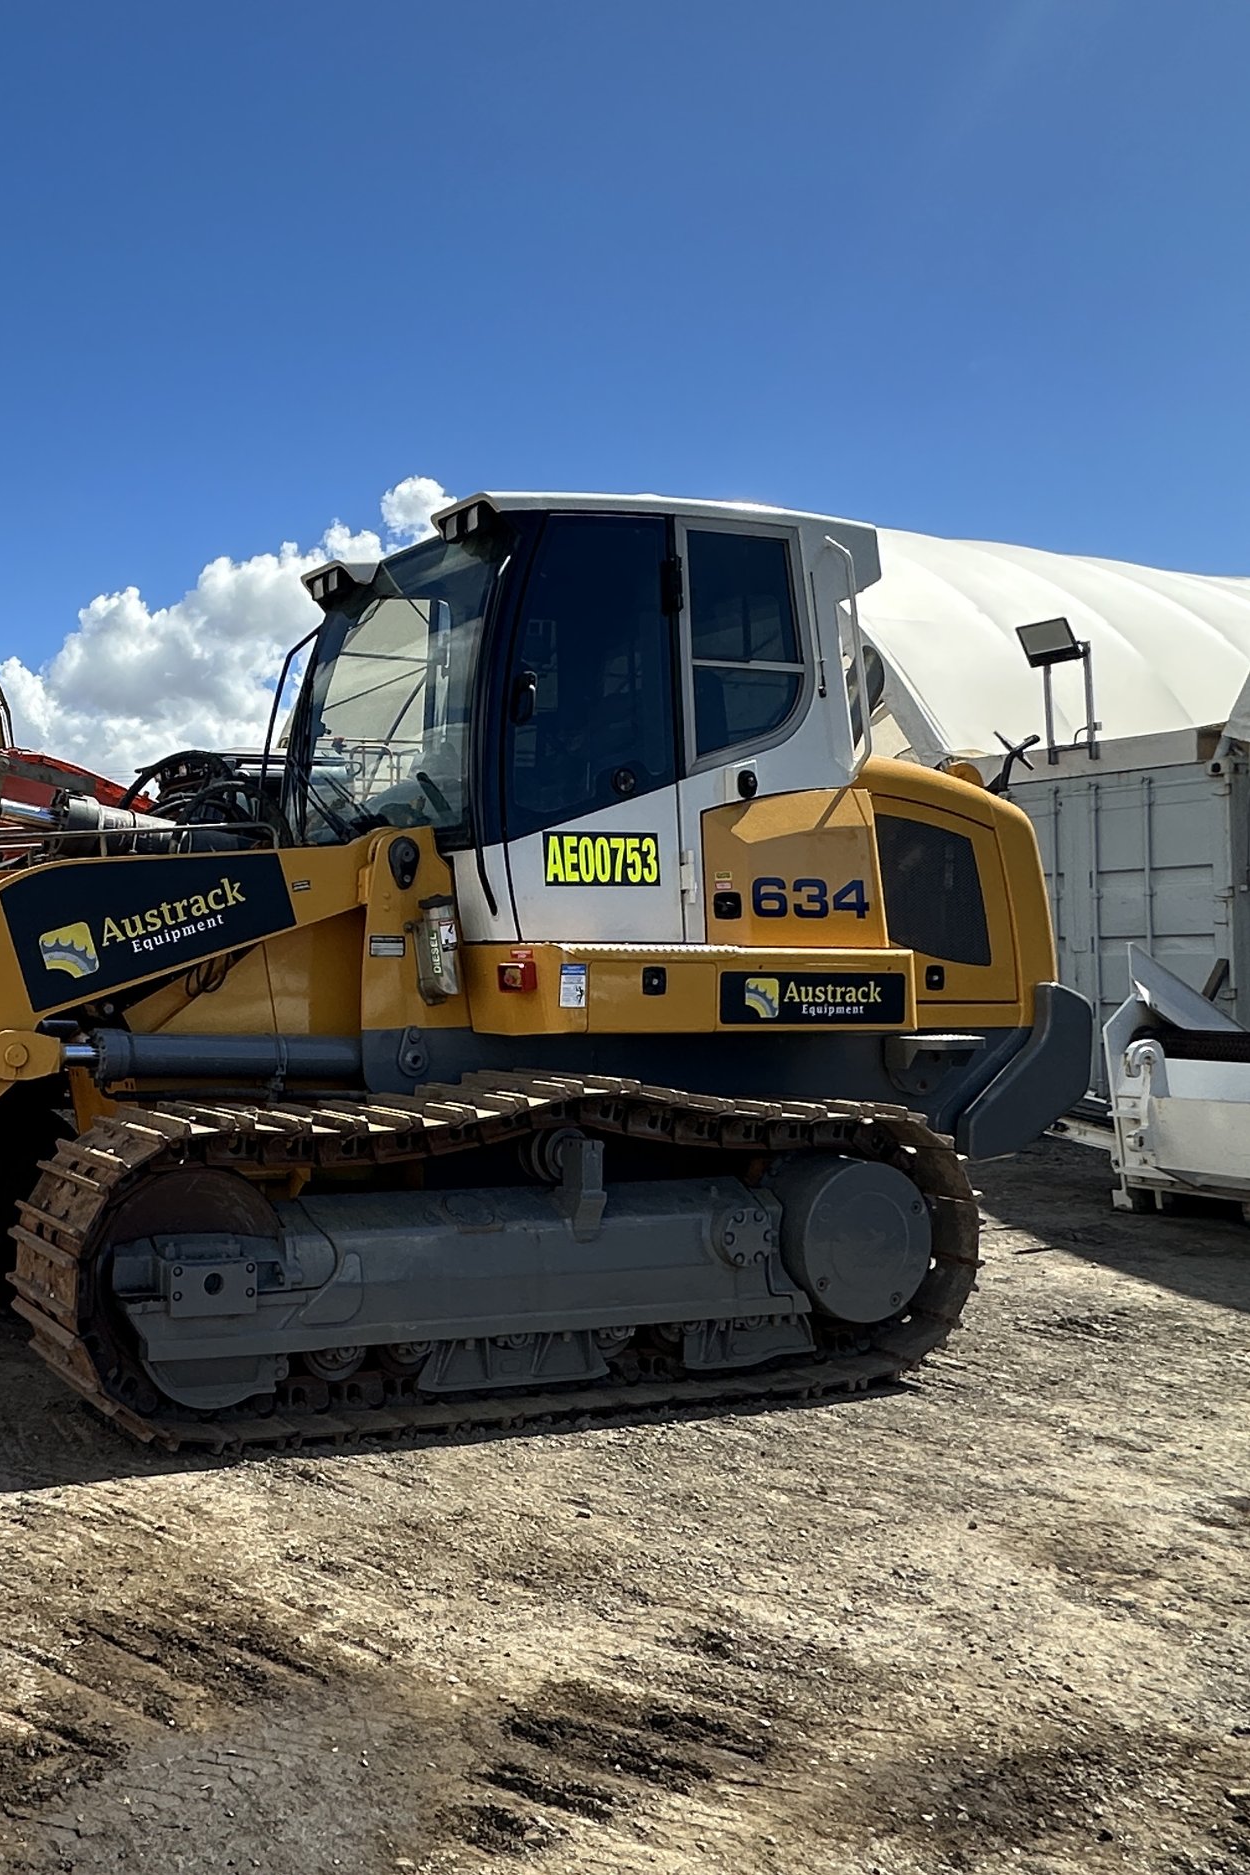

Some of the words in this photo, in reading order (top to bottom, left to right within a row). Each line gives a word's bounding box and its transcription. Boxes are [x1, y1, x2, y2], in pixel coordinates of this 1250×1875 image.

[546, 835, 658, 884] AE00753
[101, 877, 247, 947] Austrack
[752, 876, 871, 919] 634
[132, 914, 225, 953] Equipment
[429, 932, 442, 974] DIESEL
[783, 981, 882, 1003] Austrack
[801, 1004, 865, 1016] Equipment
